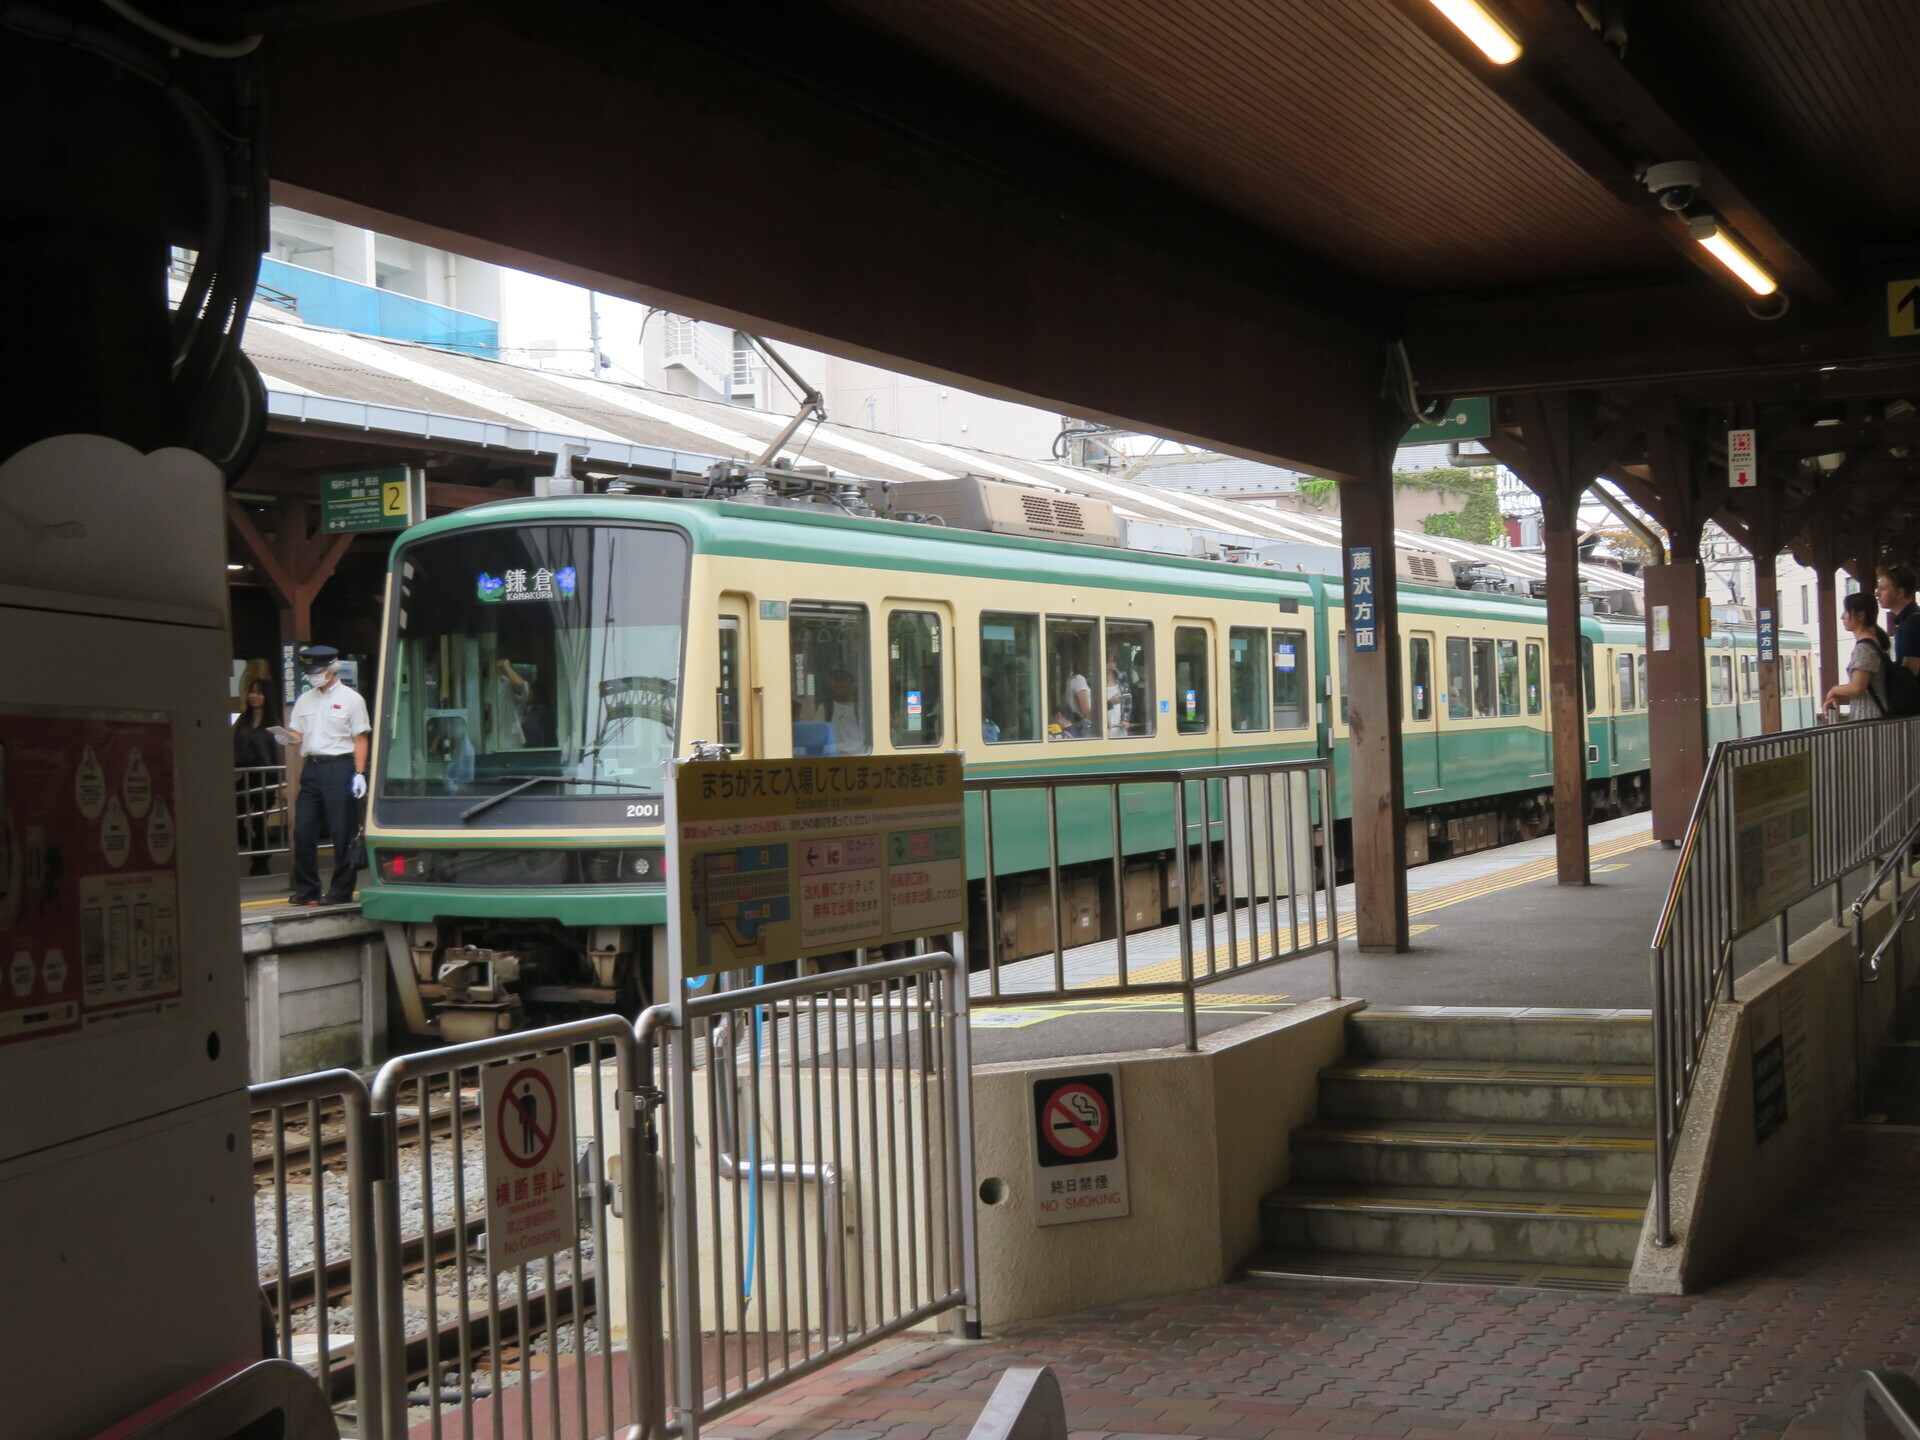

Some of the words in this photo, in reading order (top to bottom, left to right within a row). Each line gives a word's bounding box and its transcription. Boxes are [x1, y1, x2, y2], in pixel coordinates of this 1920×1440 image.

[389, 487, 400, 510] 2
[505, 567, 554, 592] 鎌倉
[506, 591, 554, 601] KAMAKURA
[1352, 551, 1375, 648] 藤沢方面
[702, 762, 947, 799] まちがえて入場してしまったお客さま
[626, 804, 659, 817] 2001
[804, 879, 875, 900] 改札機にタッチして
[813, 899, 878, 920] 無料で出場できます
[495, 1167, 566, 1208] 横断禁止
[1050, 1175, 1109, 1194] 終日禁煙
[1040, 1200, 1059, 1212] NO
[1065, 1192, 1121, 1210] SMOKING
[504, 1241, 519, 1257] No
[521, 1228, 561, 1250] Crossing
